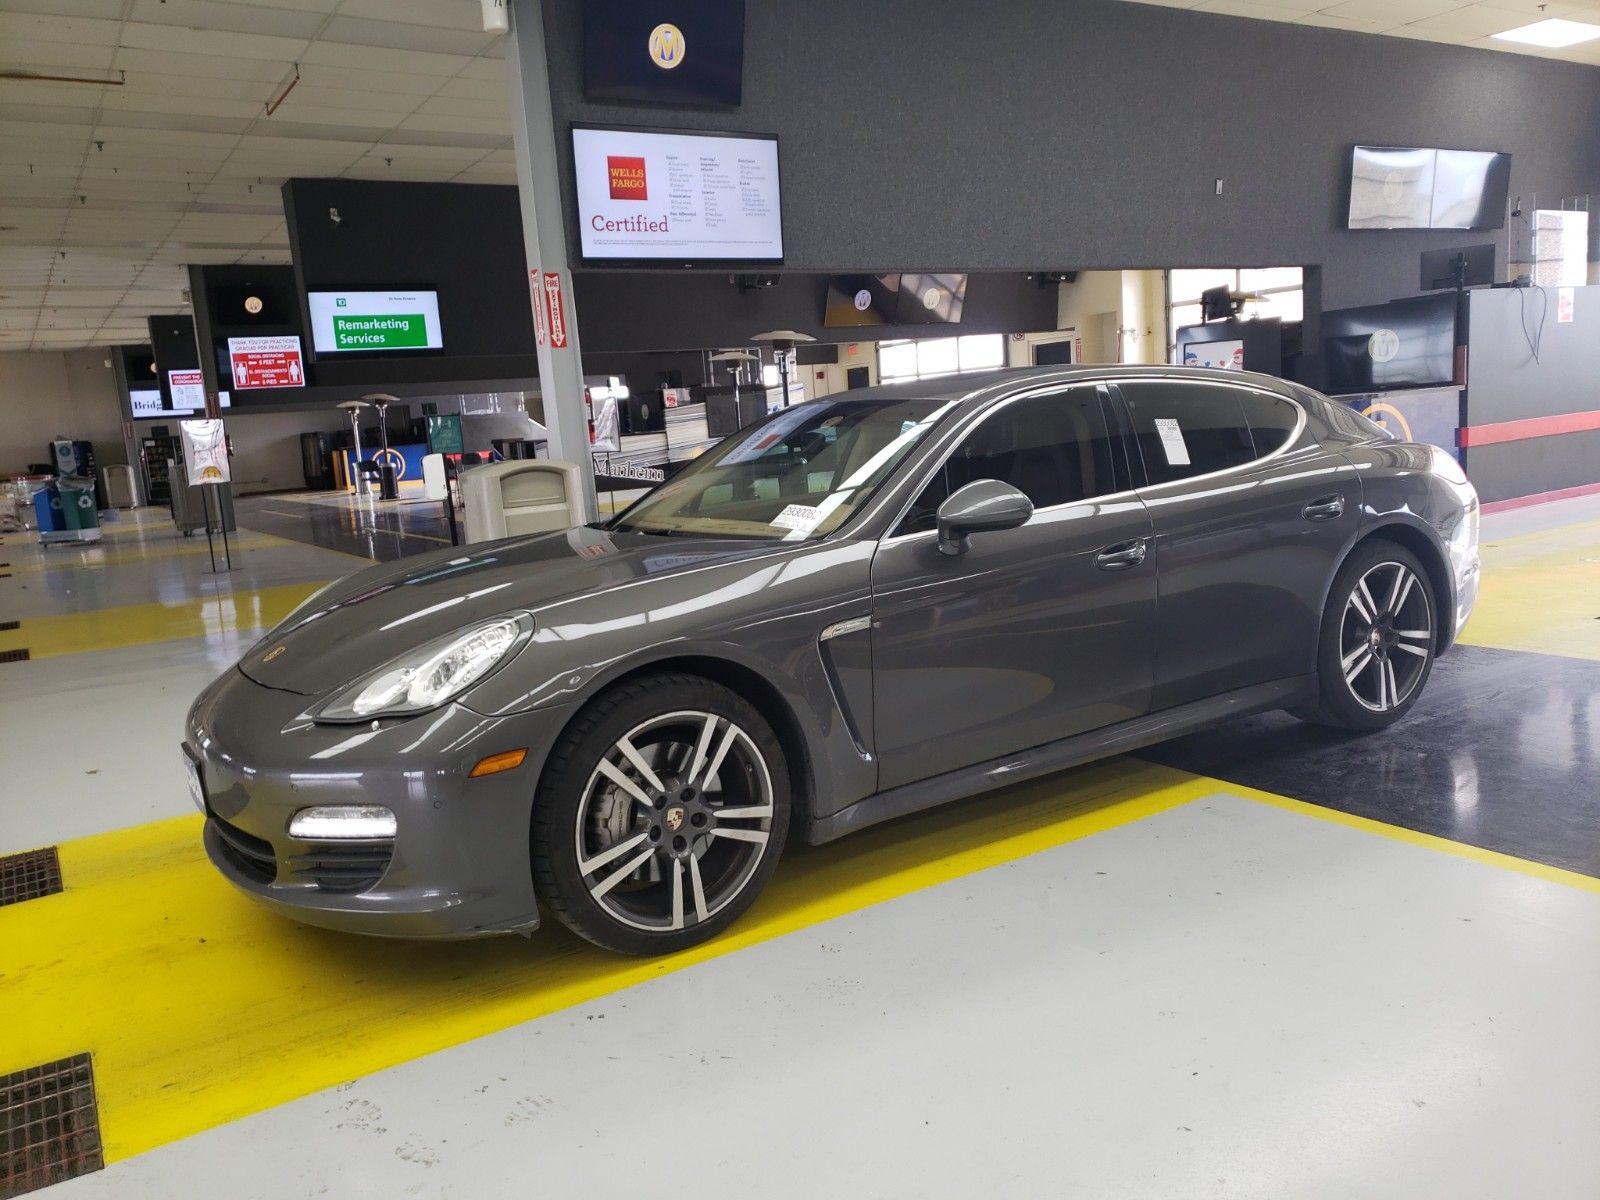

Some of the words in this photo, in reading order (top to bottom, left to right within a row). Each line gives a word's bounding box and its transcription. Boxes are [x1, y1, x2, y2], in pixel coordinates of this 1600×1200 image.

[611, 168, 643, 177] WELLS
[613, 179, 644, 188] FARGO
[592, 215, 669, 232] Certified
[551, 289, 561, 342] EXTINGUISHER
[338, 319, 409, 331] Remarketing
[340, 333, 386, 344] Services
[594, 457, 666, 481] Manheim
